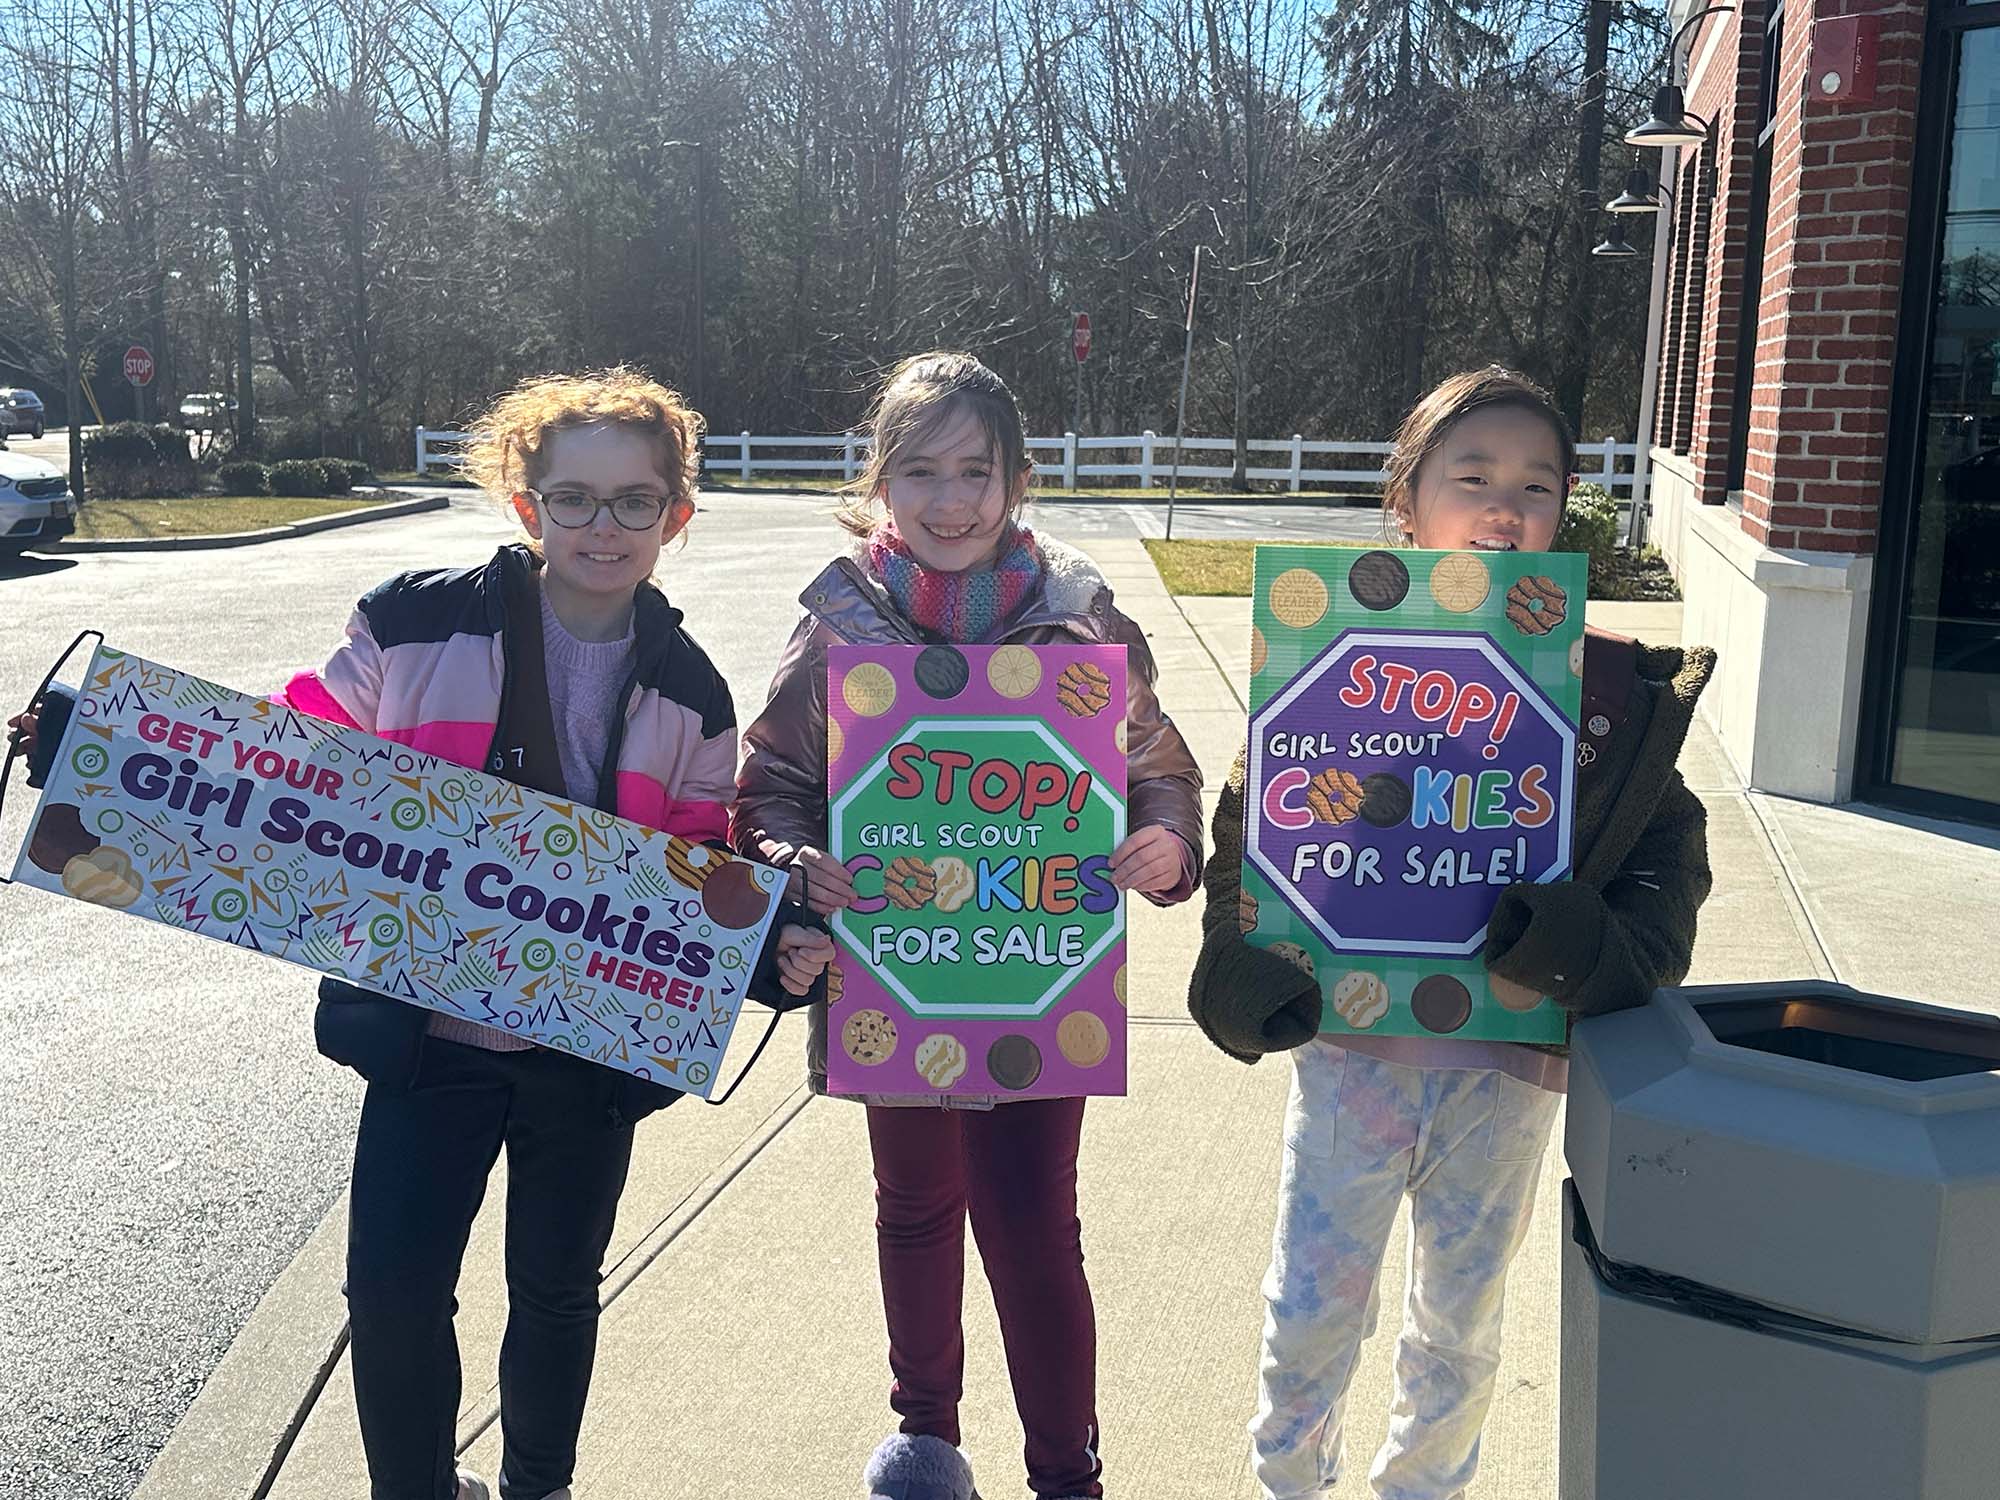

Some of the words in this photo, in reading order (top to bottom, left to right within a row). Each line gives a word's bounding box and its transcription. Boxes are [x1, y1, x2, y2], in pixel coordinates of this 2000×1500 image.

[1855, 36, 1863, 73] FIRE
[127, 359, 151, 374] STOP
[1339, 654, 1520, 760] STOP!
[138, 713, 224, 759] GET
[232, 739, 345, 799] YOUR
[1268, 731, 1337, 762] GIRL
[1347, 731, 1445, 759] SCOUT
[886, 742, 1092, 832] STOP!
[1262, 764, 1555, 833] COOKIES
[119, 752, 255, 829] Girl
[259, 796, 453, 892] Scout
[462, 861, 716, 979] Cookies
[859, 823, 926, 849] GIRL
[938, 823, 1044, 849] SCOUT
[1291, 841, 1384, 887] FOR
[1401, 836, 1527, 888] SALE!
[843, 853, 1120, 915] COOKIES
[871, 924, 961, 967] FOR
[972, 924, 1085, 967] SALE
[585, 950, 705, 1013] HERE!
